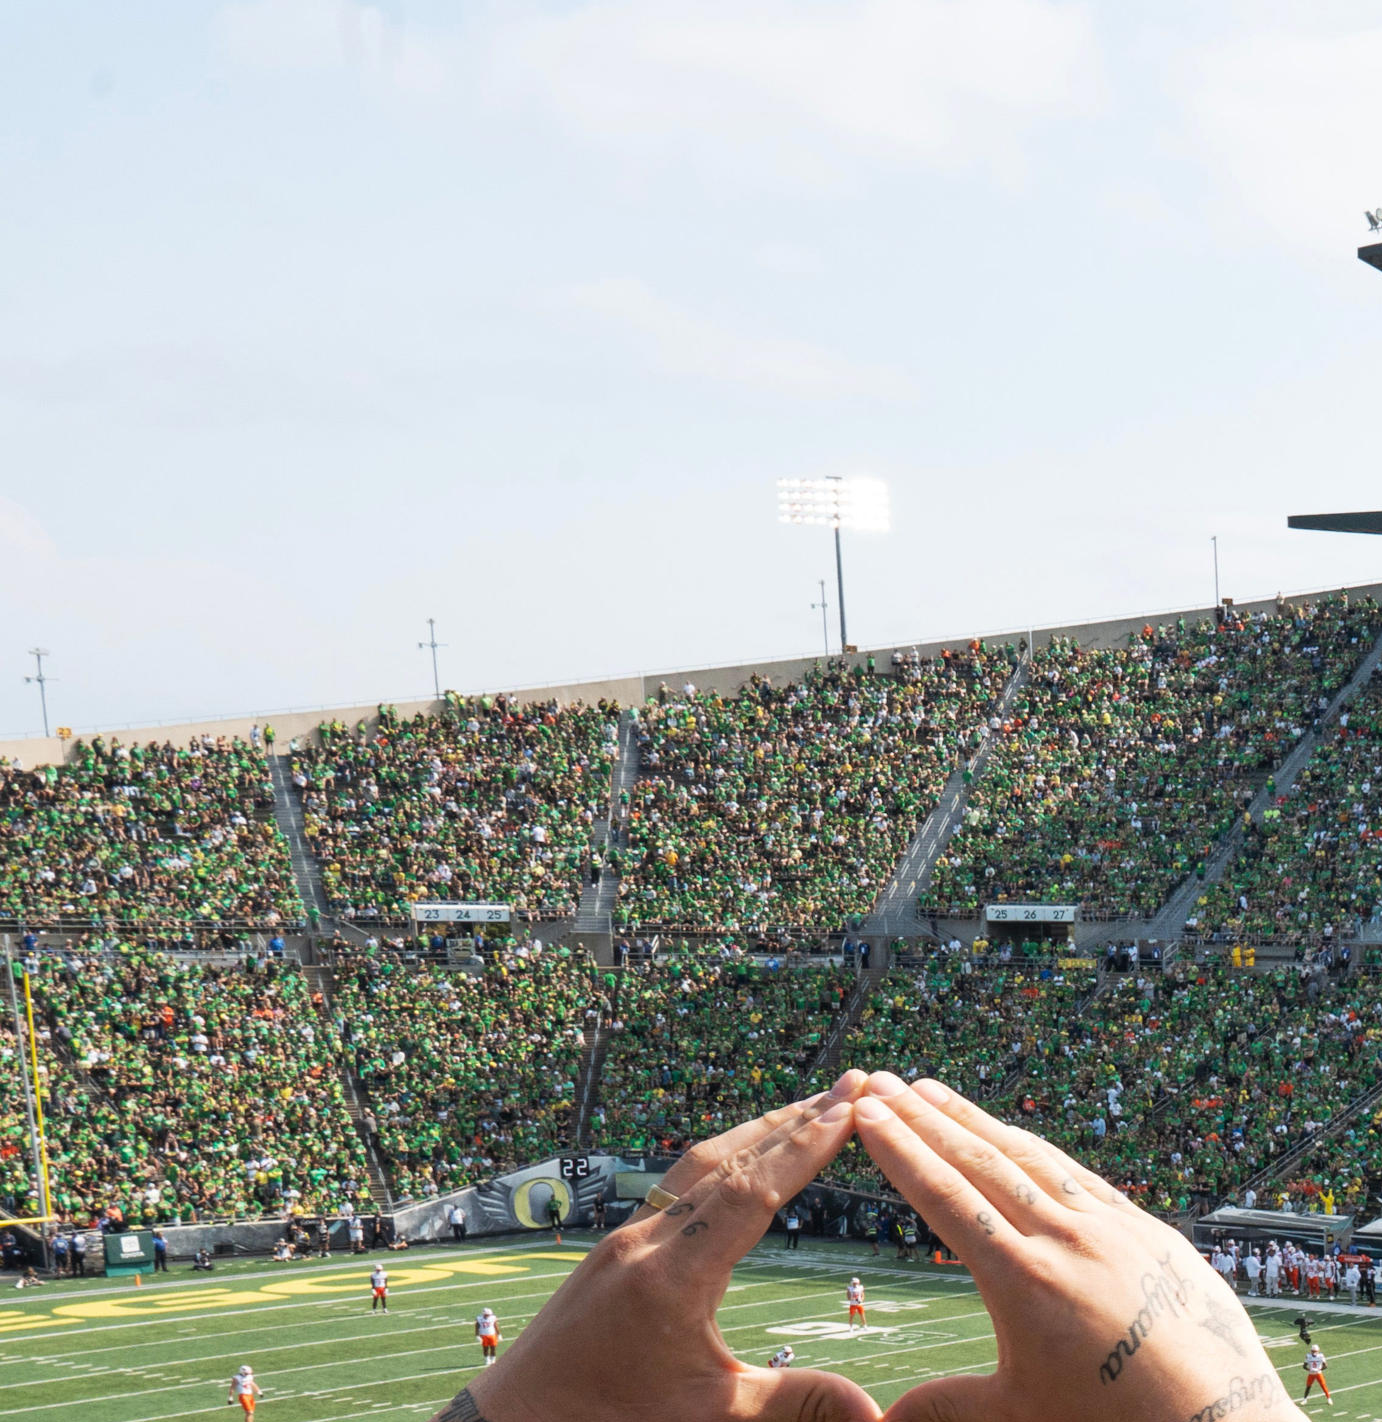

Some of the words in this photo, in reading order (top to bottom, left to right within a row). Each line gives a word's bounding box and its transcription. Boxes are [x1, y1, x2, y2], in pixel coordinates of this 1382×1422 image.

[424, 909, 440, 919] 23
[455, 910, 471, 919] 24
[486, 910, 502, 920] 25
[994, 910, 1008, 919] 25
[1023, 910, 1037, 919] 26
[1053, 910, 1065, 919] 27
[563, 1158, 588, 1177] 22
